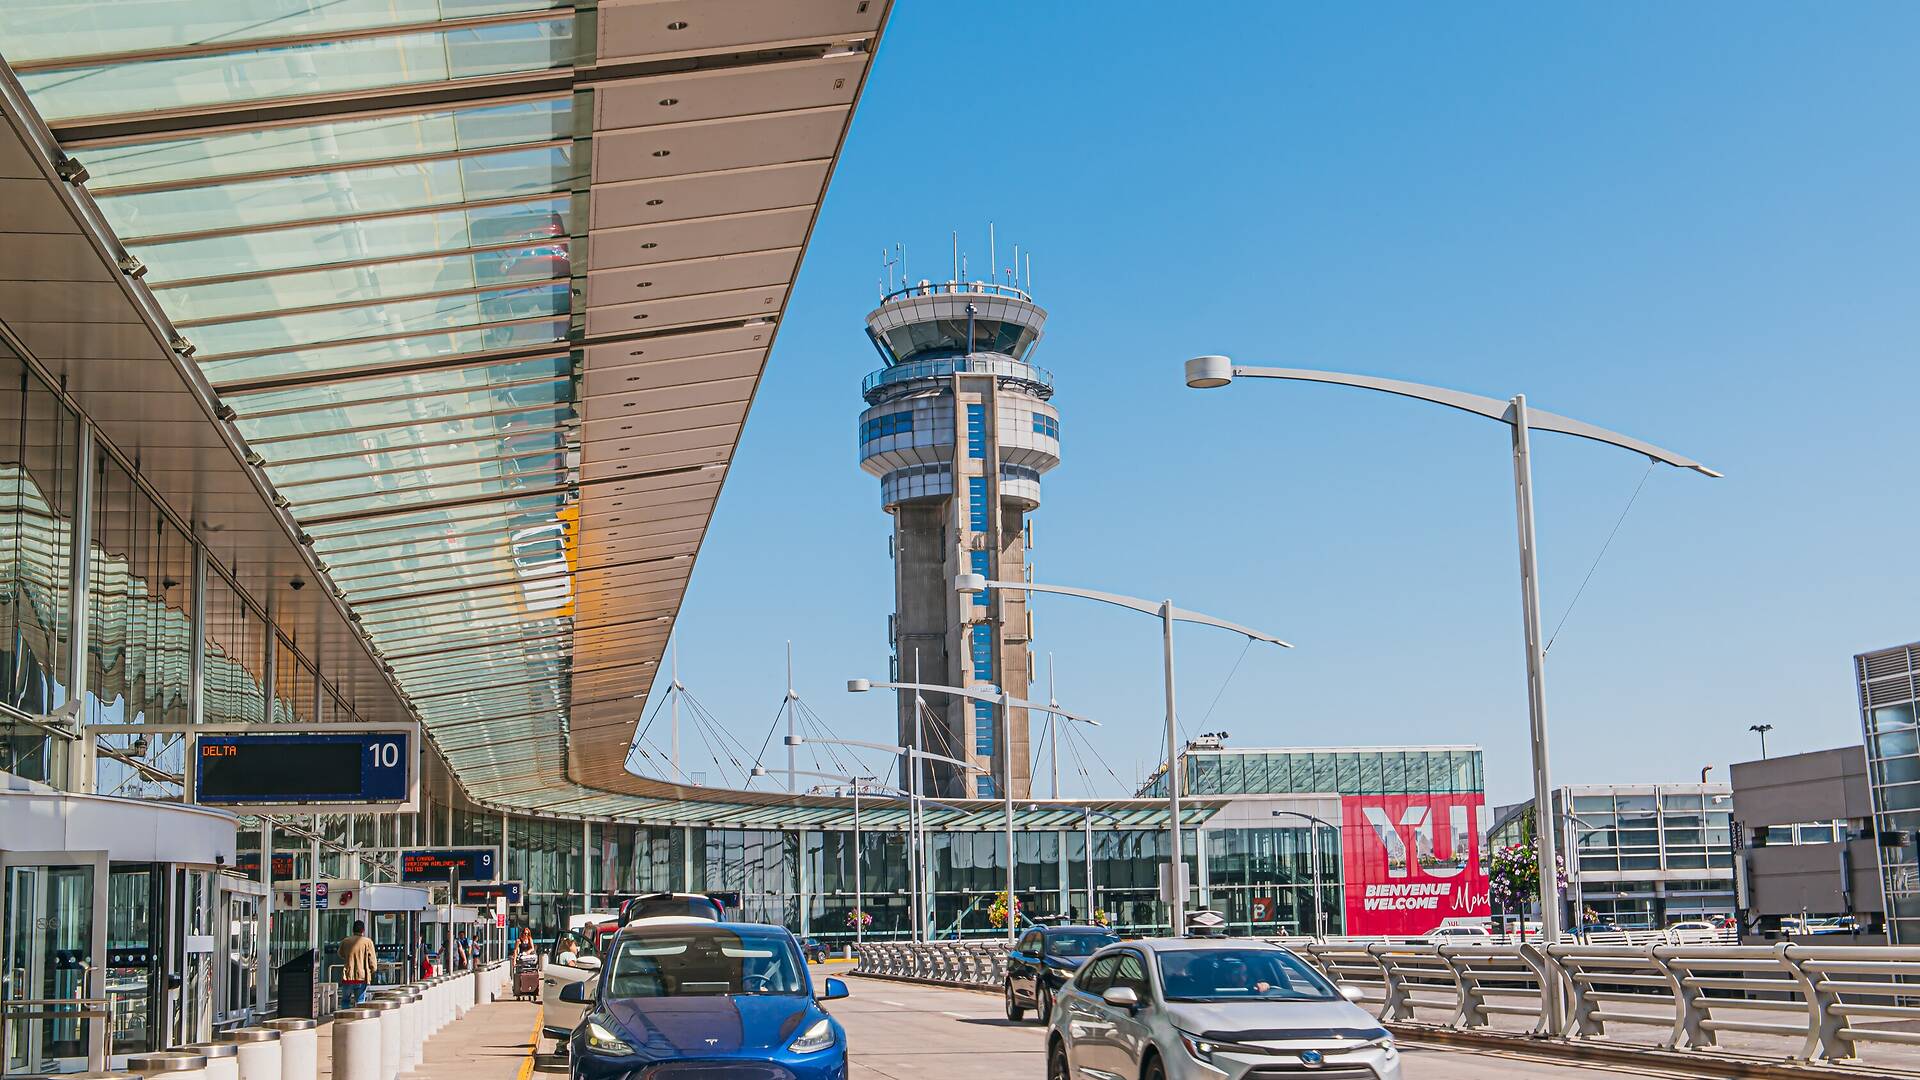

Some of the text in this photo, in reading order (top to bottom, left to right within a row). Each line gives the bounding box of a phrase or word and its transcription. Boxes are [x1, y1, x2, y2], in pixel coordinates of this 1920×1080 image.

[202, 745, 237, 756] DELTA
[369, 742, 399, 768] 10
[482, 854, 491, 866] 9
[512, 886, 518, 894] 8
[1365, 883, 1452, 897] BIENVENUE
[1363, 896, 1439, 911] WELCOME
